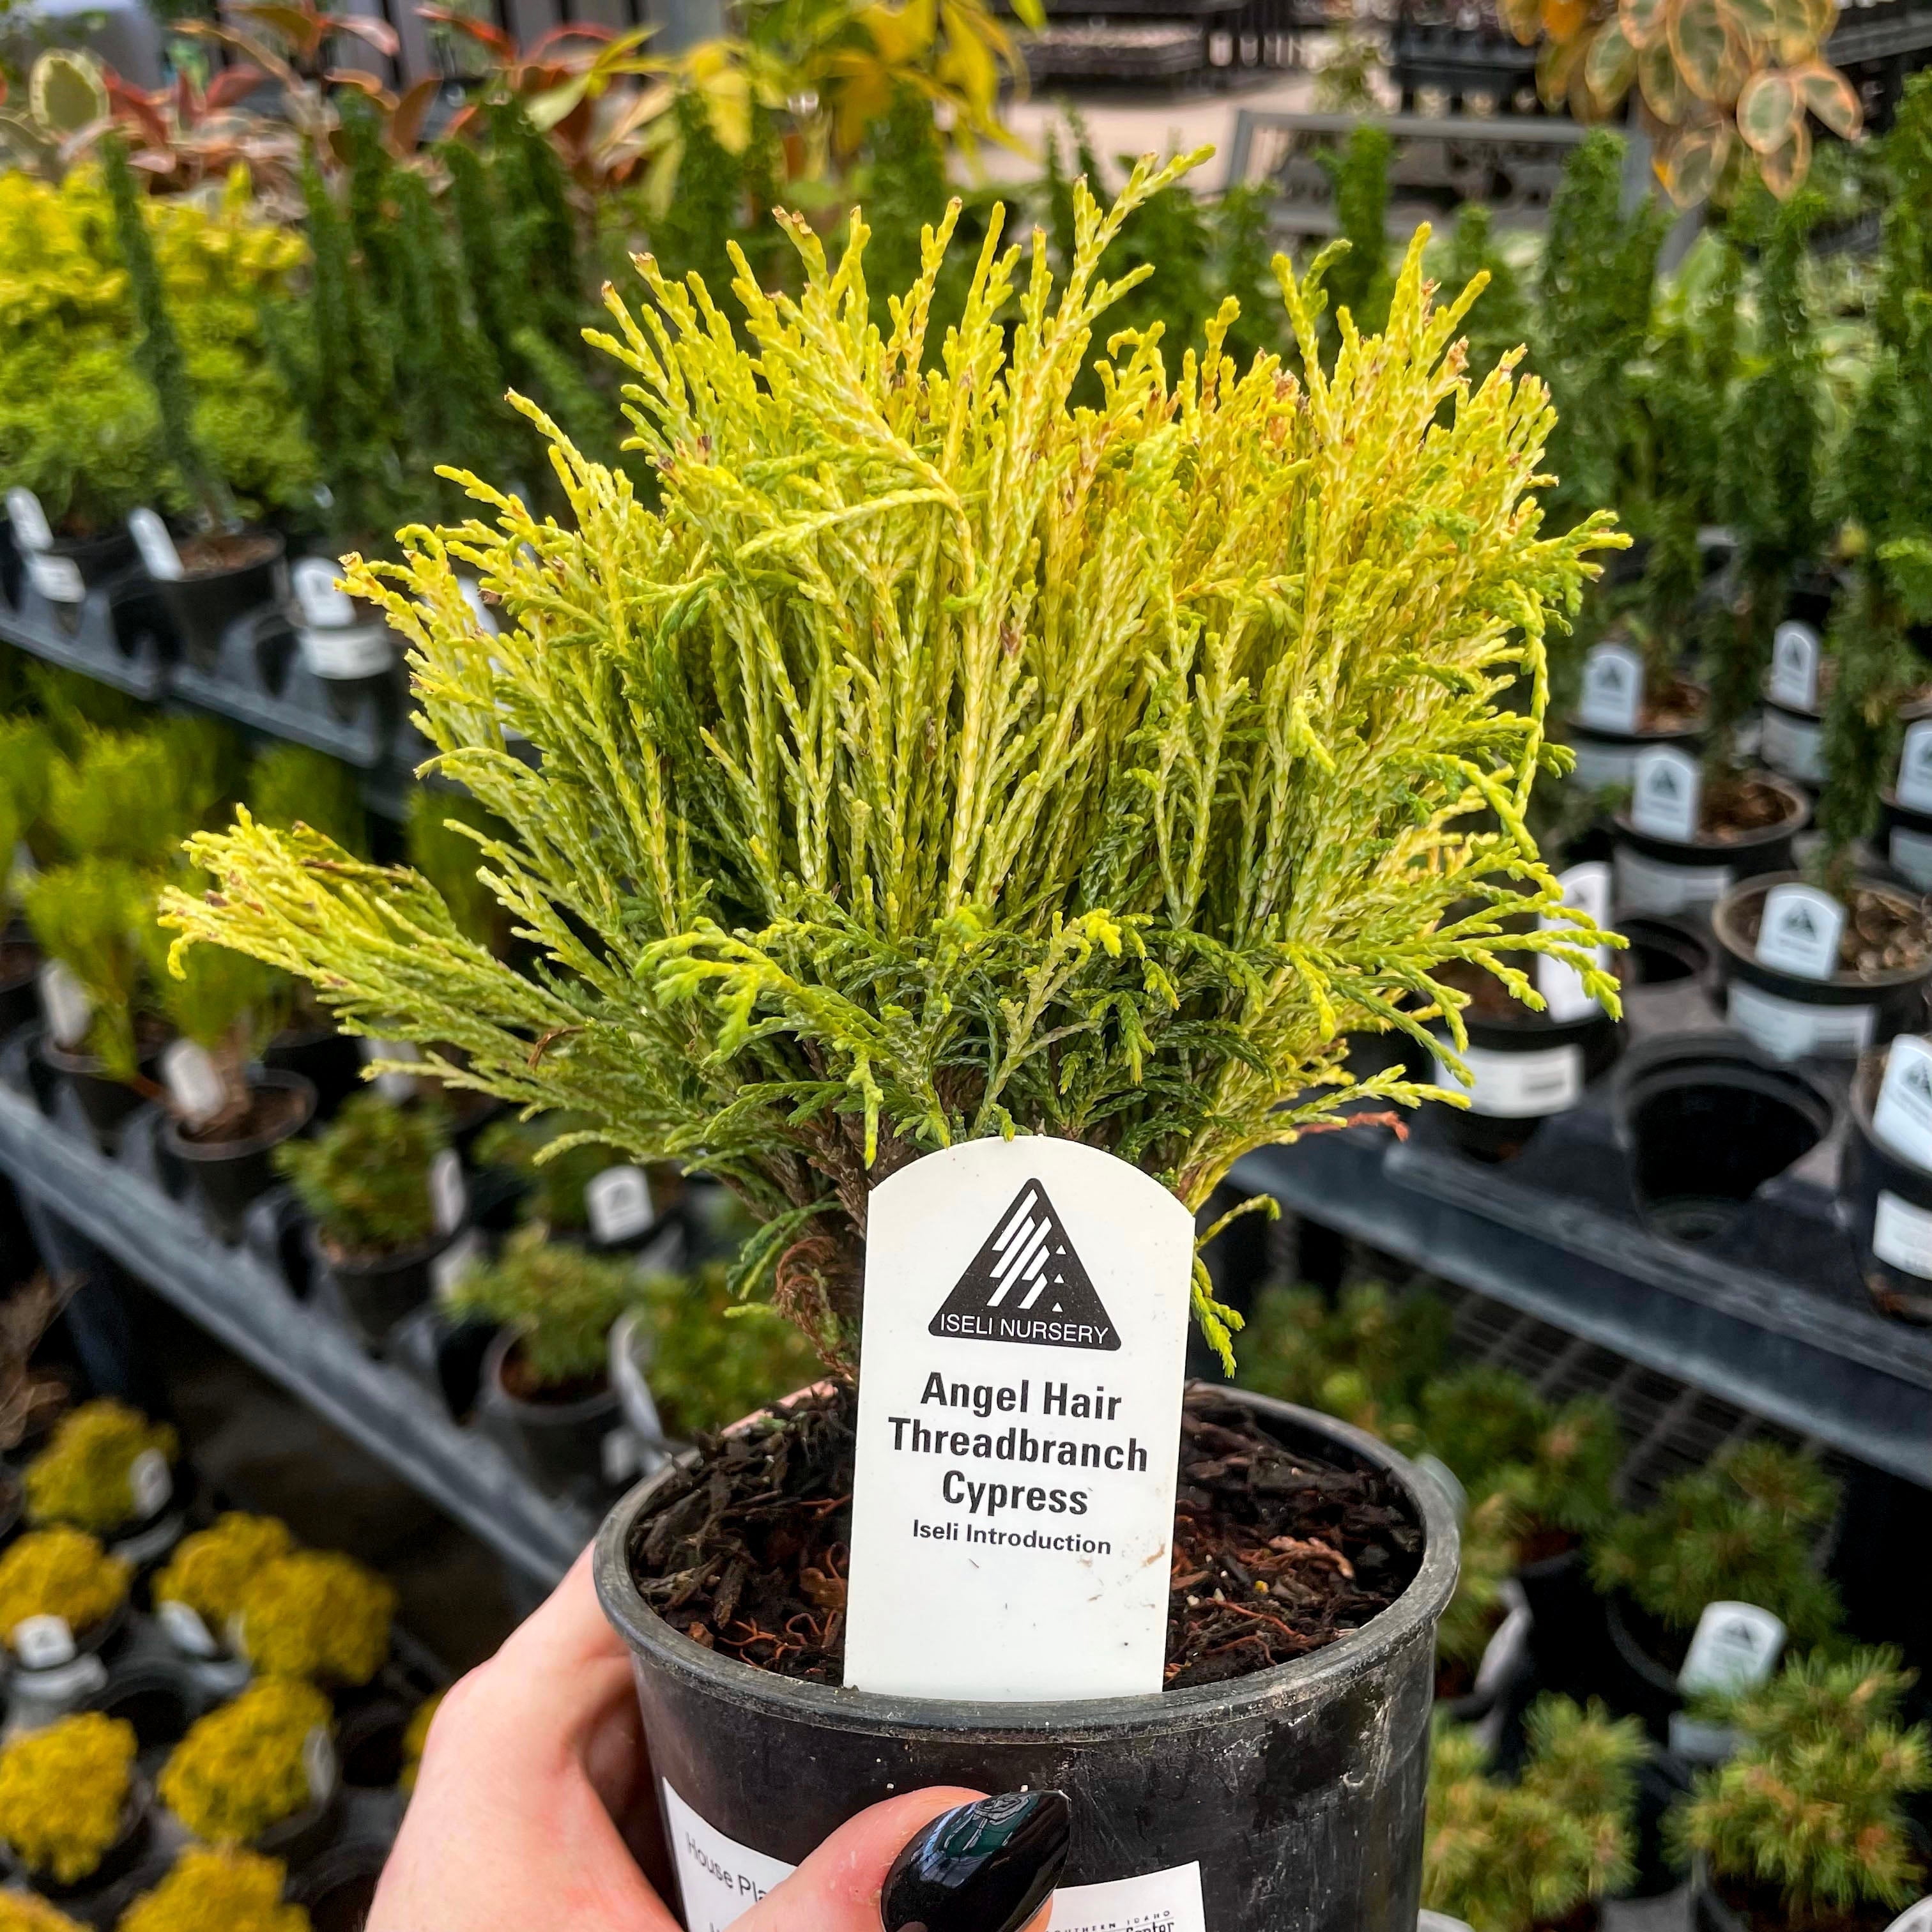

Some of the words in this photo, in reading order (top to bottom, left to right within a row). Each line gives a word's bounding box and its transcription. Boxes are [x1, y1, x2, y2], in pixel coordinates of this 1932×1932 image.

[940, 1313, 993, 1335] ISELI
[1000, 1317, 1108, 1344] NURSERY
[920, 1372, 1029, 1418] Angel
[1043, 1381, 1122, 1420] Hair
[888, 1416, 1147, 1472] Threadbranch
[943, 1470, 1088, 1517] Cypress
[914, 1519, 958, 1540] Iseli
[967, 1524, 1111, 1554] Introduction
[686, 1831, 733, 1889] House
[1127, 1910, 1170, 1925] IDAHO
